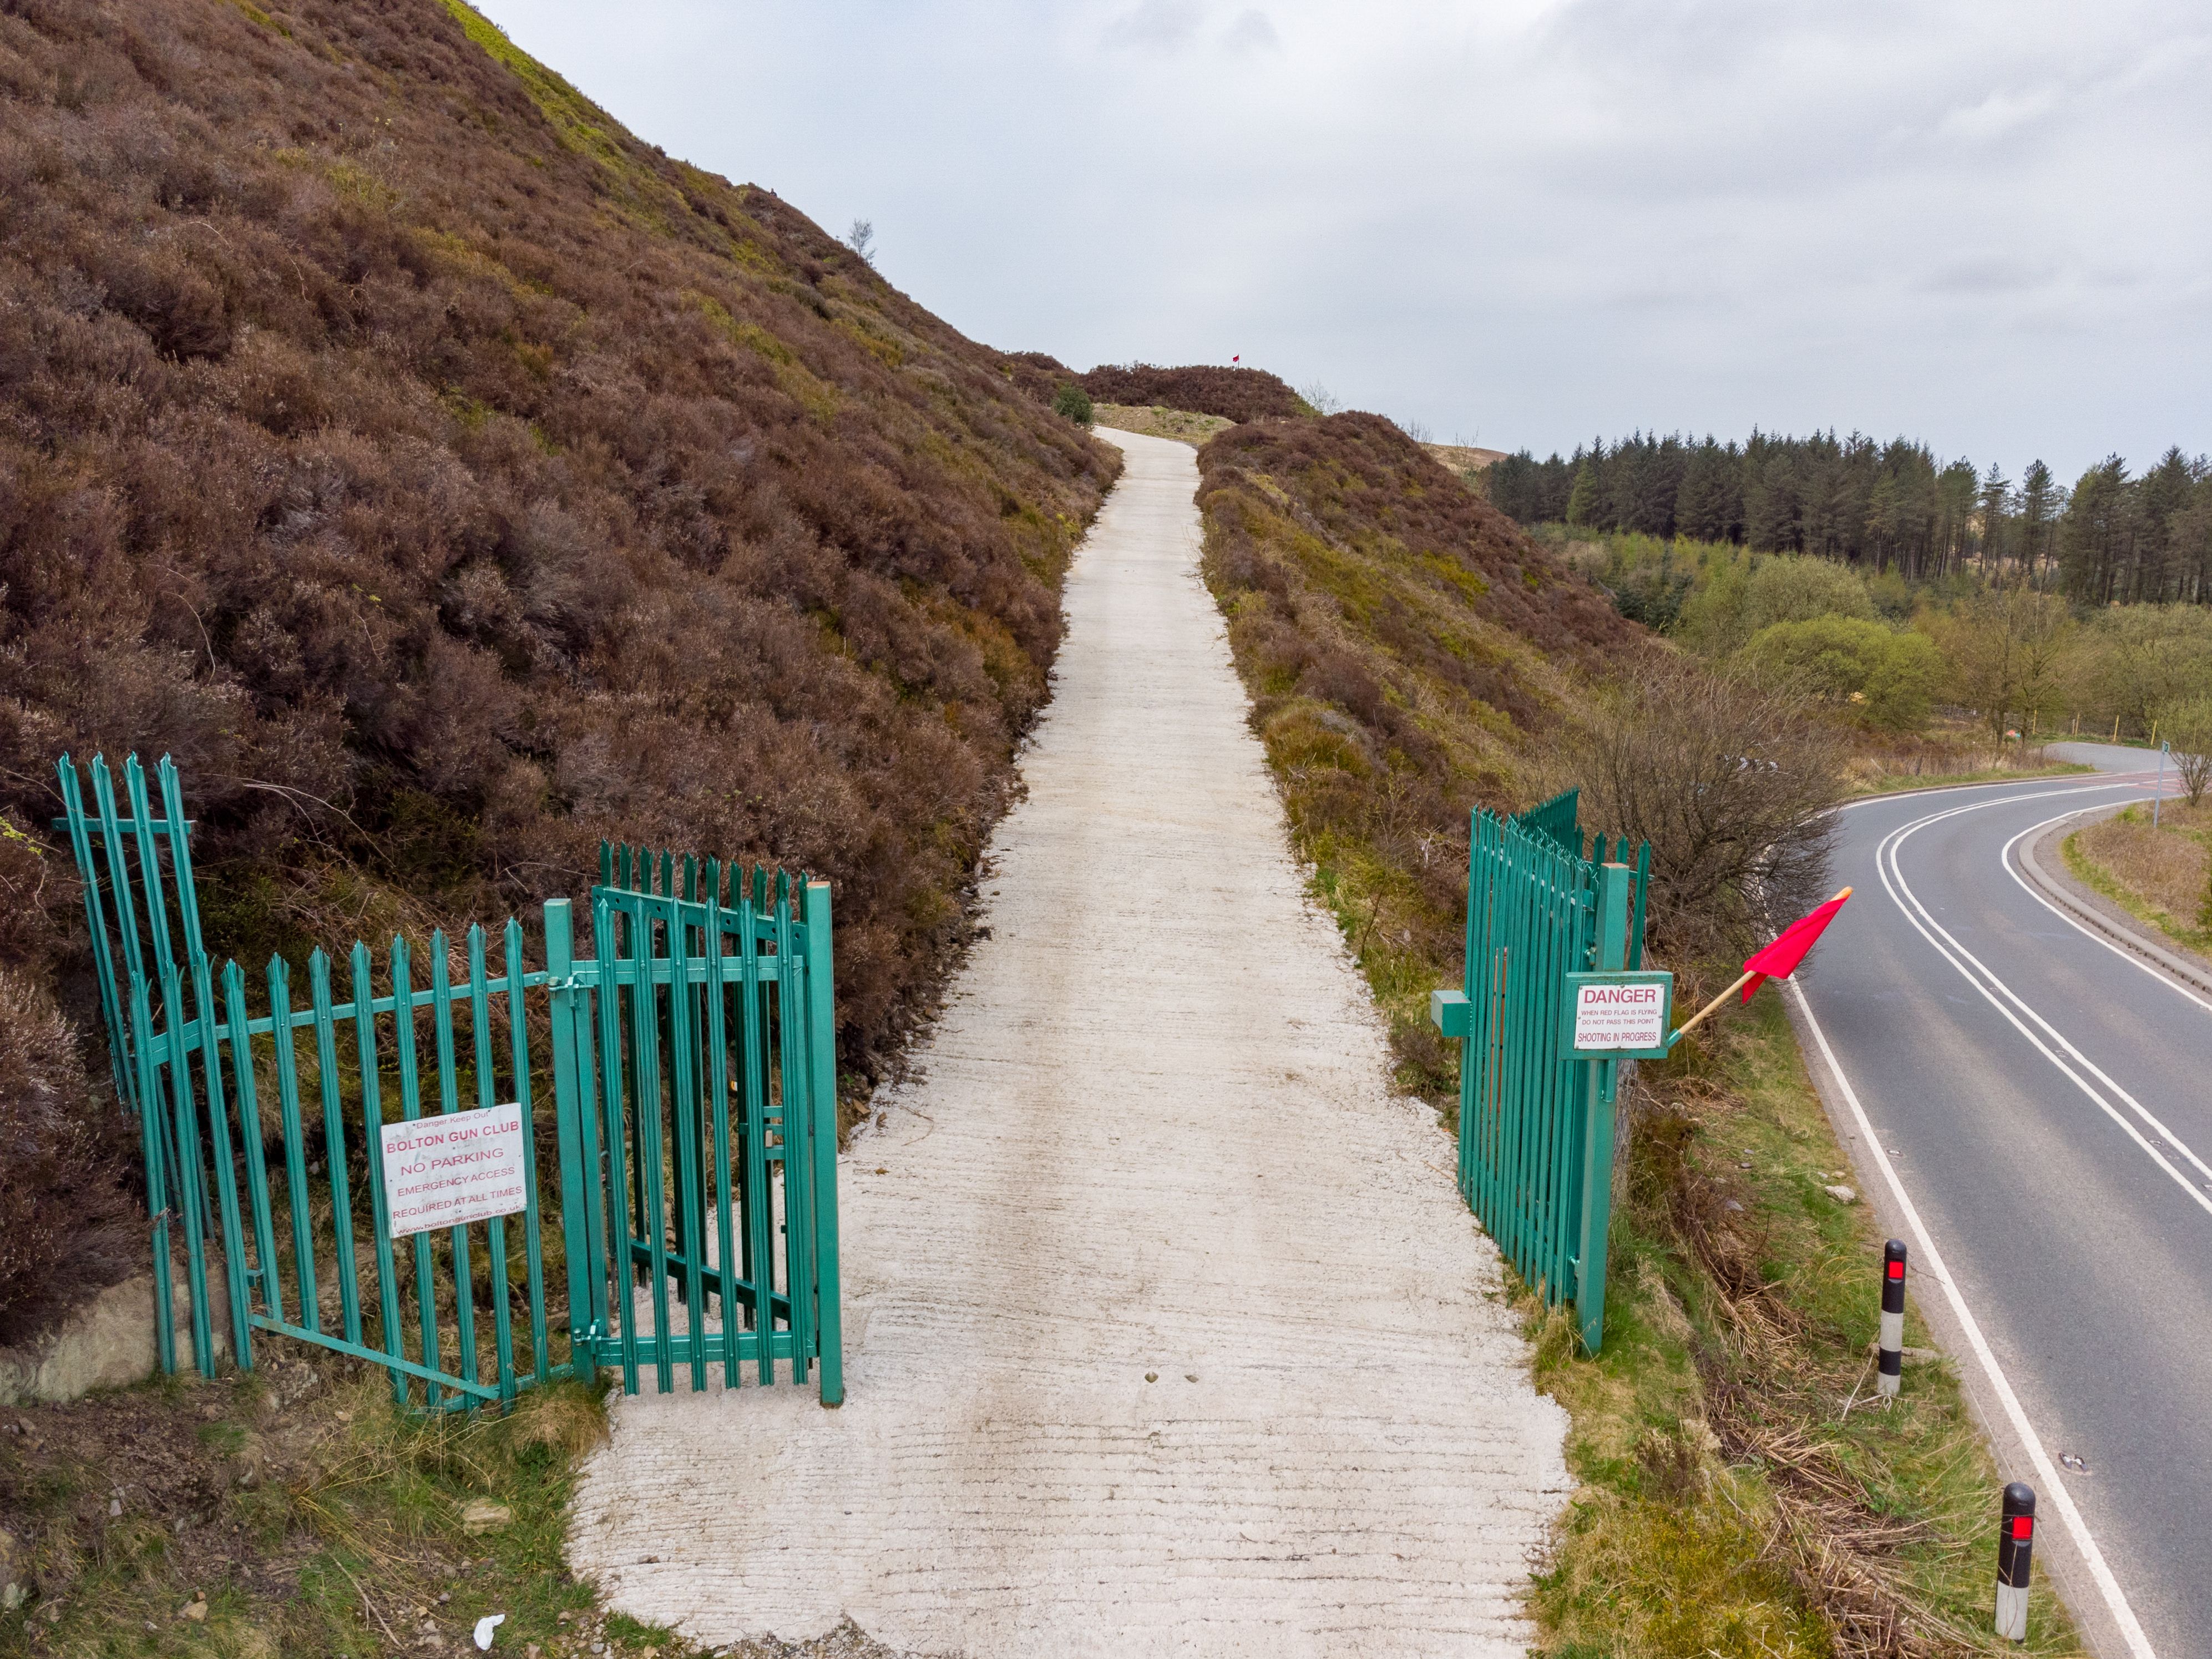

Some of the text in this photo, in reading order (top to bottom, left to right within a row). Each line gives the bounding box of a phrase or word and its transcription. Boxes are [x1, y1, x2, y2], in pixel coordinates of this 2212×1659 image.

[1585, 989, 1656, 1003] DANGER
[1578, 1032, 1656, 1042] SHOOTING IN PROGRESS
[417, 1119, 447, 1129] Danger
[451, 1115, 471, 1124] Keep
[387, 1121, 519, 1154] BOLTON GUN CLUB
[401, 1148, 504, 1176] NO PARKING
[398, 1167, 515, 1197] EMERGENCY ACCESS
[393, 1186, 522, 1219] REQUIRED AT ALL TIMES
